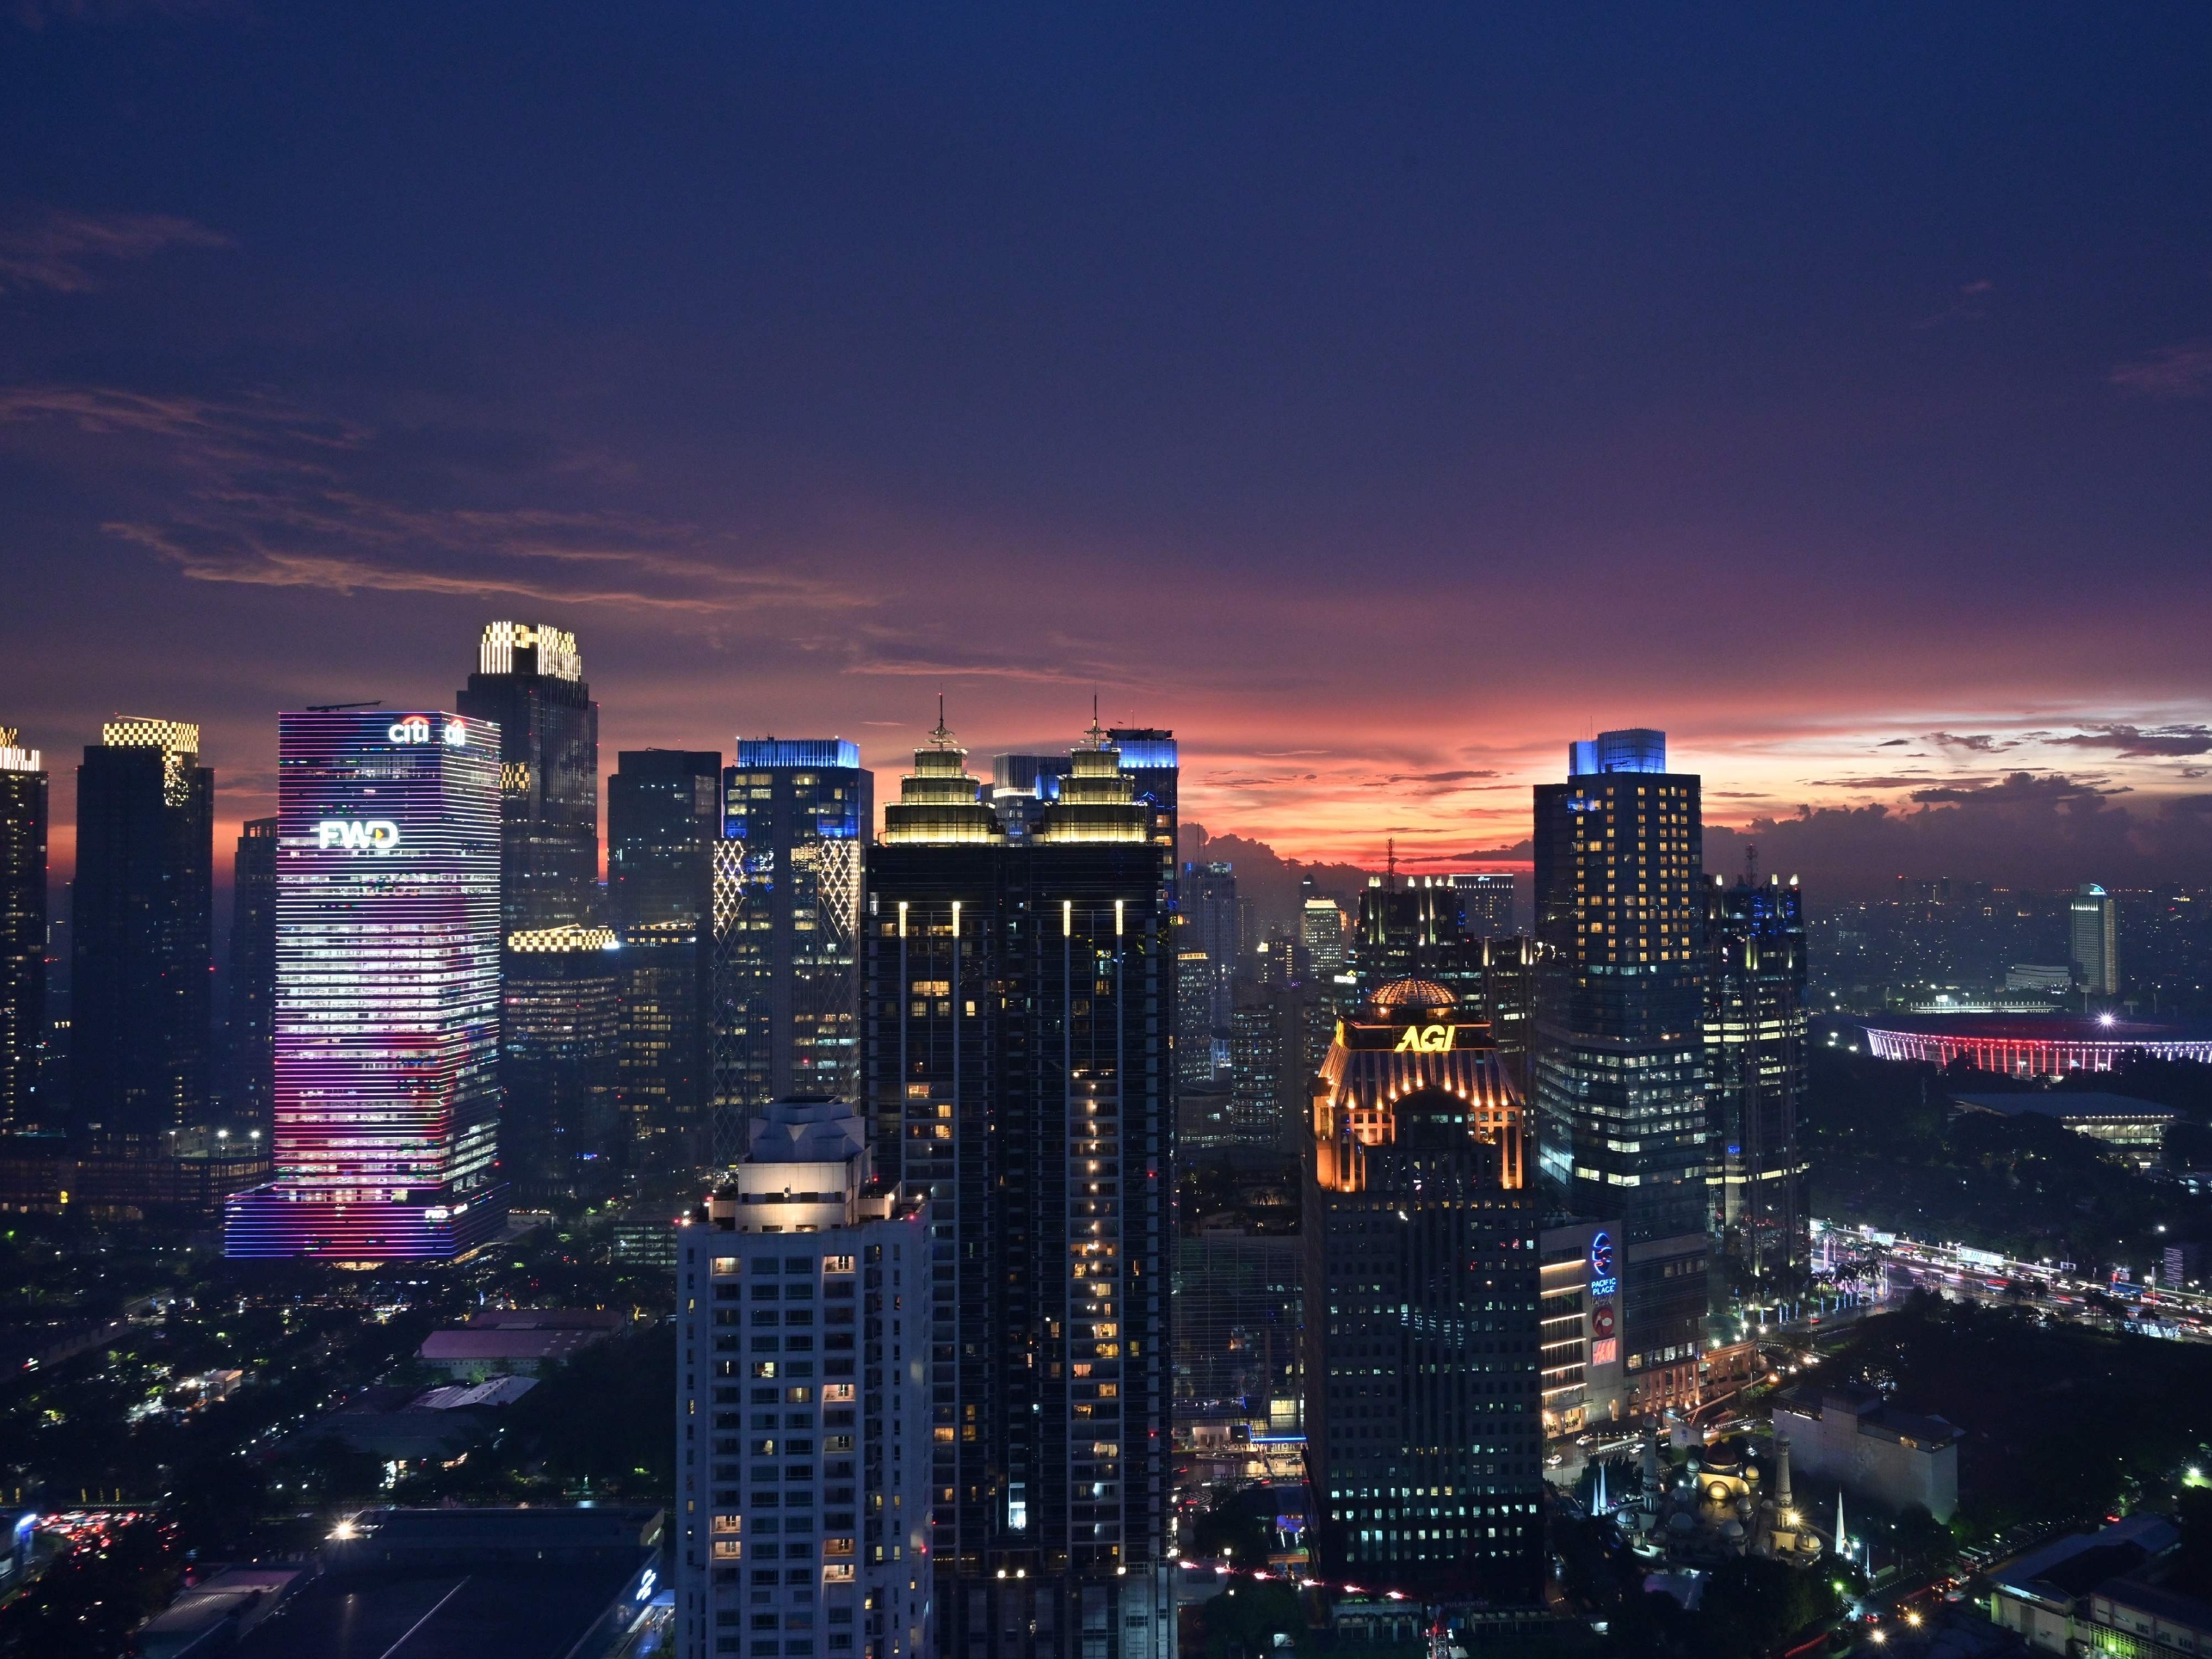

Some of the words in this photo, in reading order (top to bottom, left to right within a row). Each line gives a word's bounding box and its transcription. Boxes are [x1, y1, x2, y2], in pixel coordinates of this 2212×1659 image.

[389, 720, 429, 742] citi
[319, 821, 398, 849] FWD
[1394, 1024, 1455, 1052] AGI
[1591, 1277, 1616, 1289] PACIFIC
[1593, 1285, 1615, 1295] PLACE
